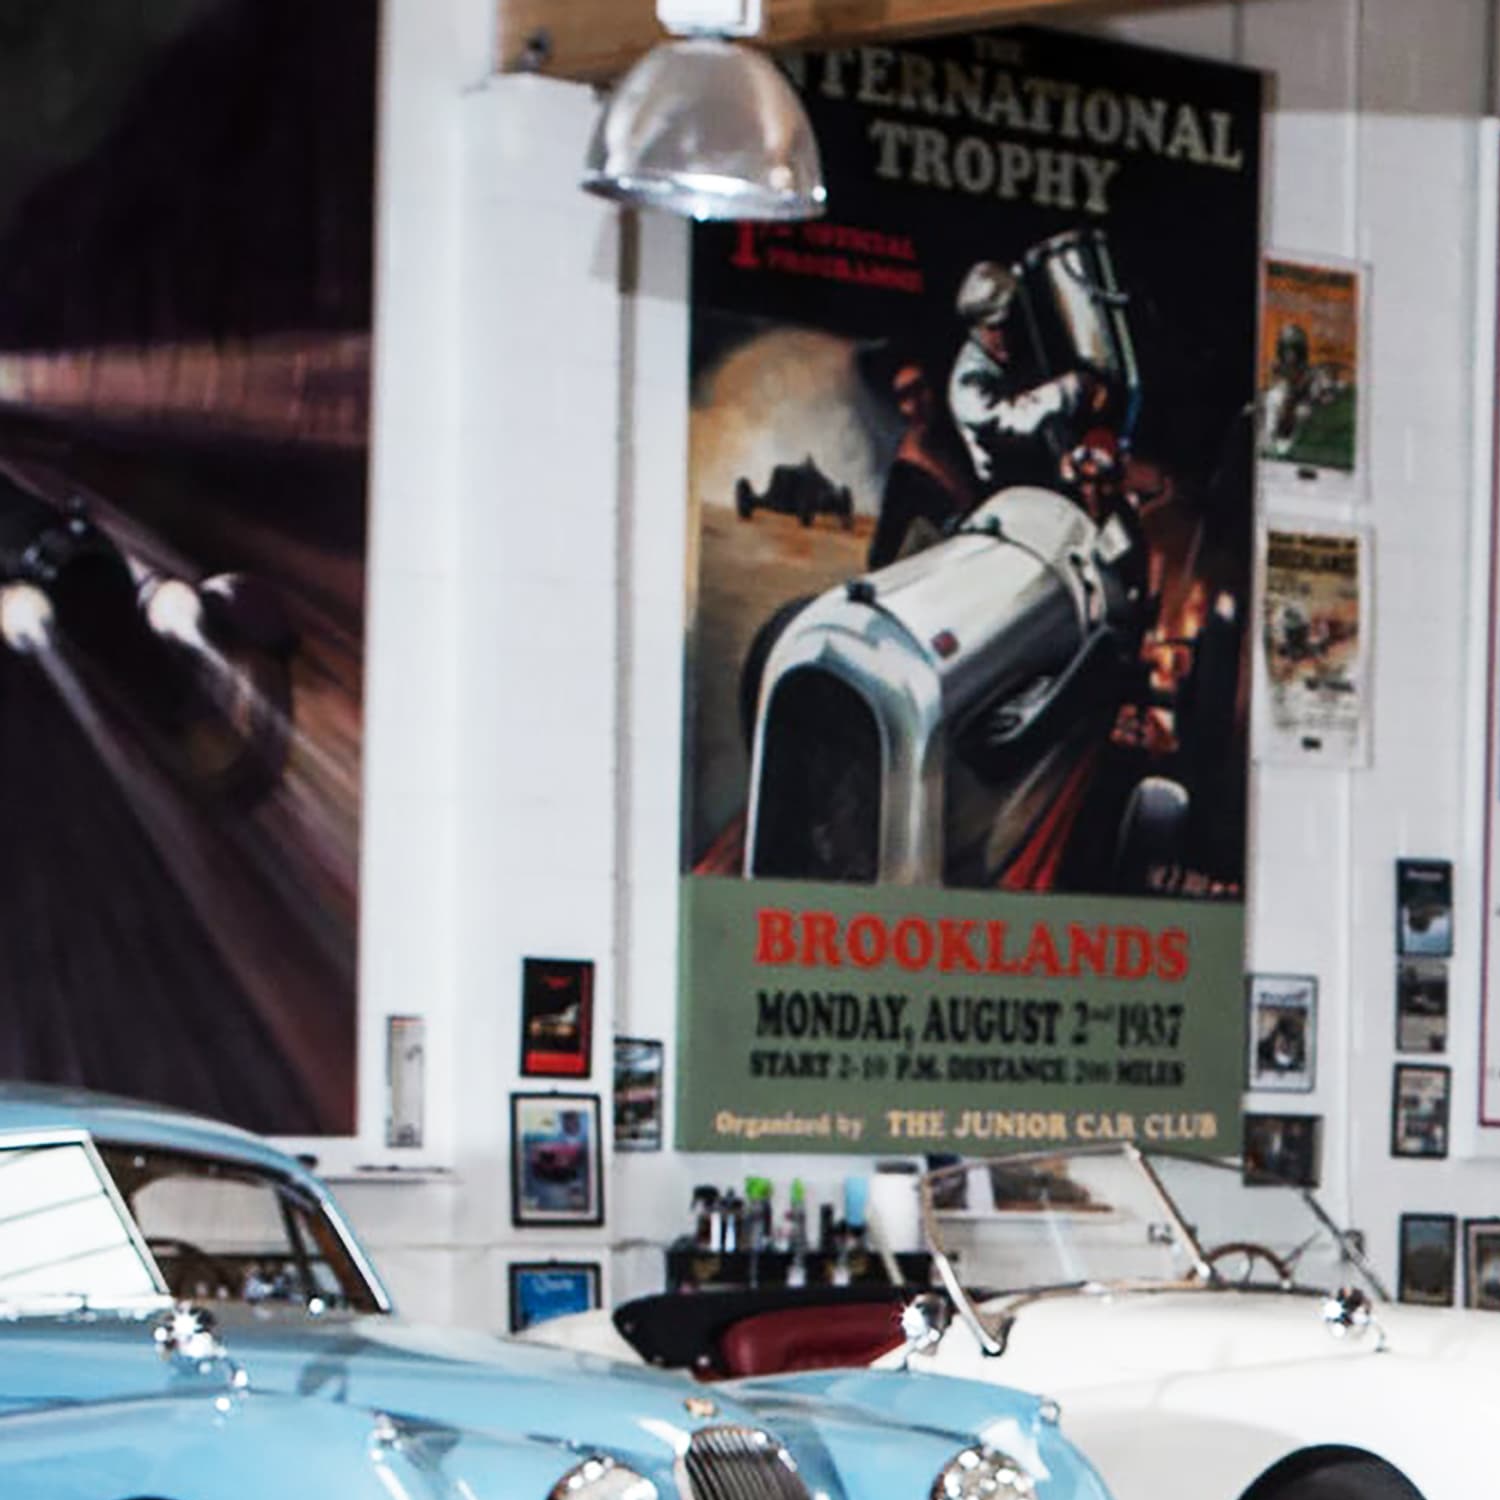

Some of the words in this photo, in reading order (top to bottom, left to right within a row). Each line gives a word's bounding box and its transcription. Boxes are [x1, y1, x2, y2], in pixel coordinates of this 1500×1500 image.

[869, 119, 1119, 214] TROPHY
[754, 908, 1190, 983] BROOKLANDS
[755, 990, 915, 1050] MONDAY,
[921, 995, 1064, 1046] AUGUST
[1117, 1001, 1185, 1050] 1937
[750, 1049, 830, 1079] START
[947, 1055, 1067, 1085] DISTANCE
[1115, 1058, 1186, 1087] MILES
[836, 1110, 864, 1141] by
[885, 1109, 945, 1138] THE
[952, 1110, 1068, 1140] JUNIOR
[1074, 1111, 1137, 1140] CAR
[1144, 1111, 1218, 1139] CLUB
